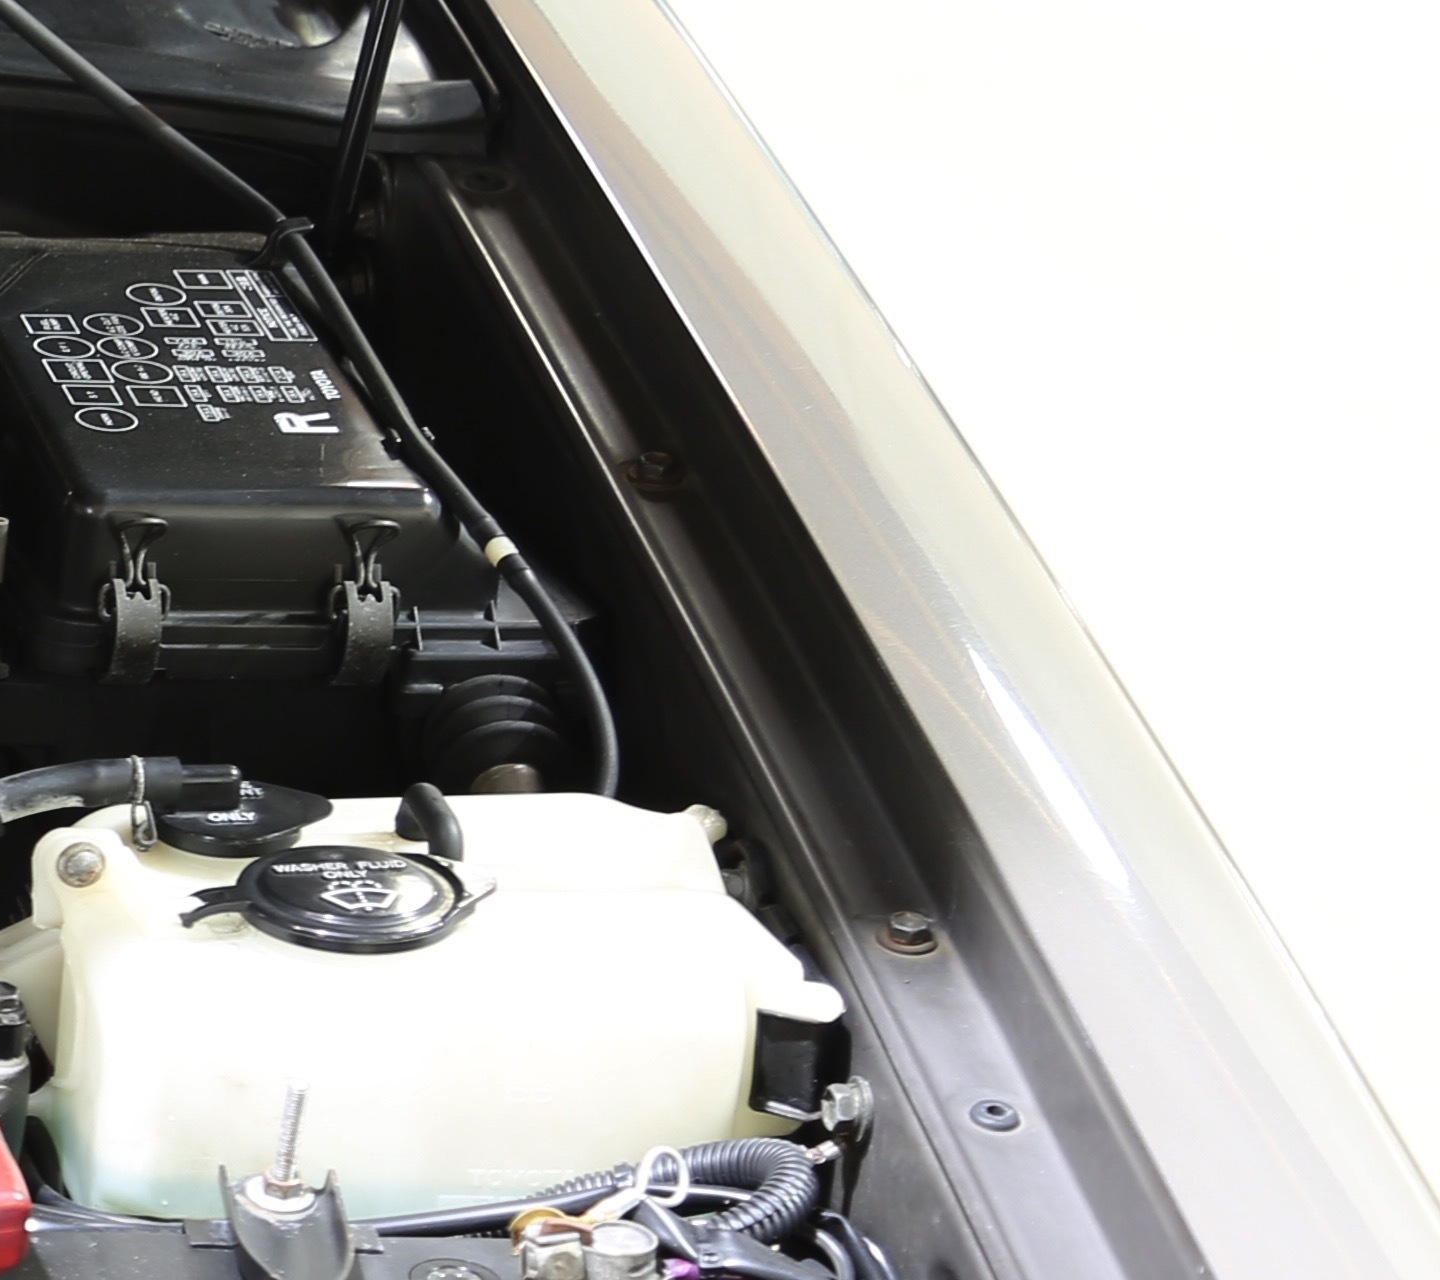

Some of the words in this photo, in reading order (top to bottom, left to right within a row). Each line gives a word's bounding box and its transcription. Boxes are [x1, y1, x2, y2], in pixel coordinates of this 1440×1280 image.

[309, 369, 341, 401] TOYOTA
[207, 812, 256, 823] ONLY
[272, 862, 349, 874] WASHER
[355, 860, 407, 870] FLUID
[323, 870, 368, 880] ONLY
